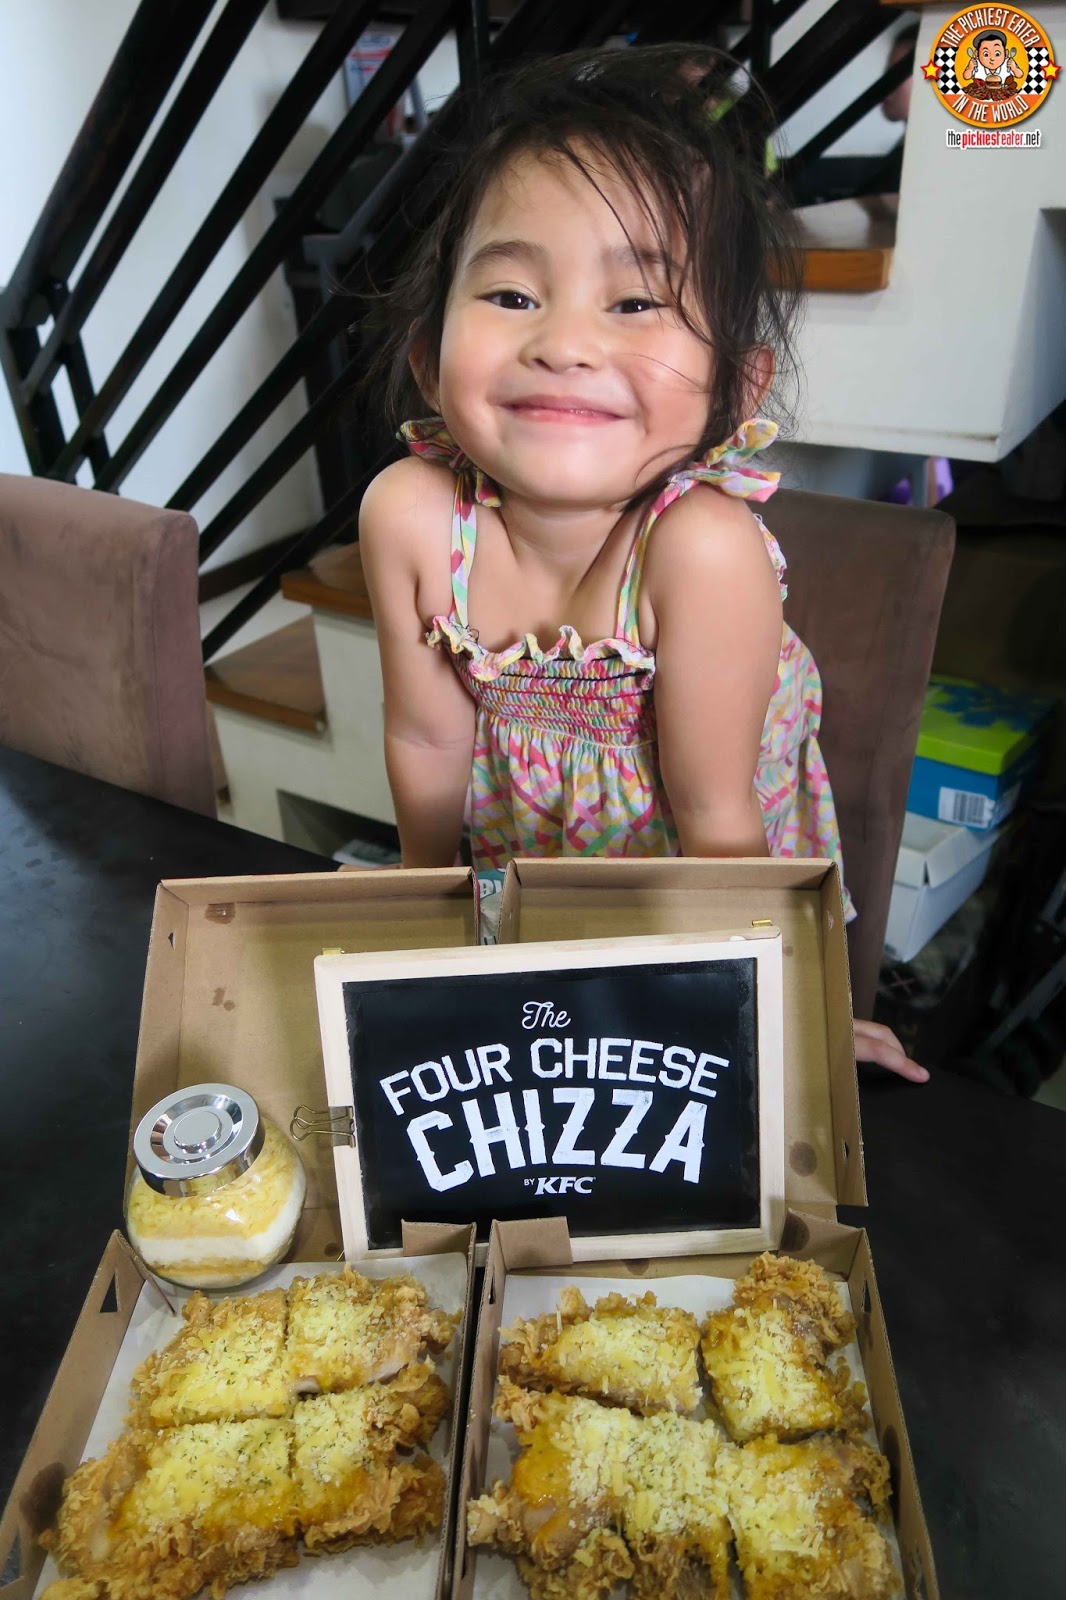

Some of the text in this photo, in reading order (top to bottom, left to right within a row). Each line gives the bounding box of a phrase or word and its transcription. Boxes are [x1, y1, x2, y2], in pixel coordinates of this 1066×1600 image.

[521, 1000, 572, 1030] The
[379, 1037, 730, 1116] FOUR CHEESE
[406, 1087, 708, 1193] CHIZZA
[523, 1176, 595, 1196] BY KFC
